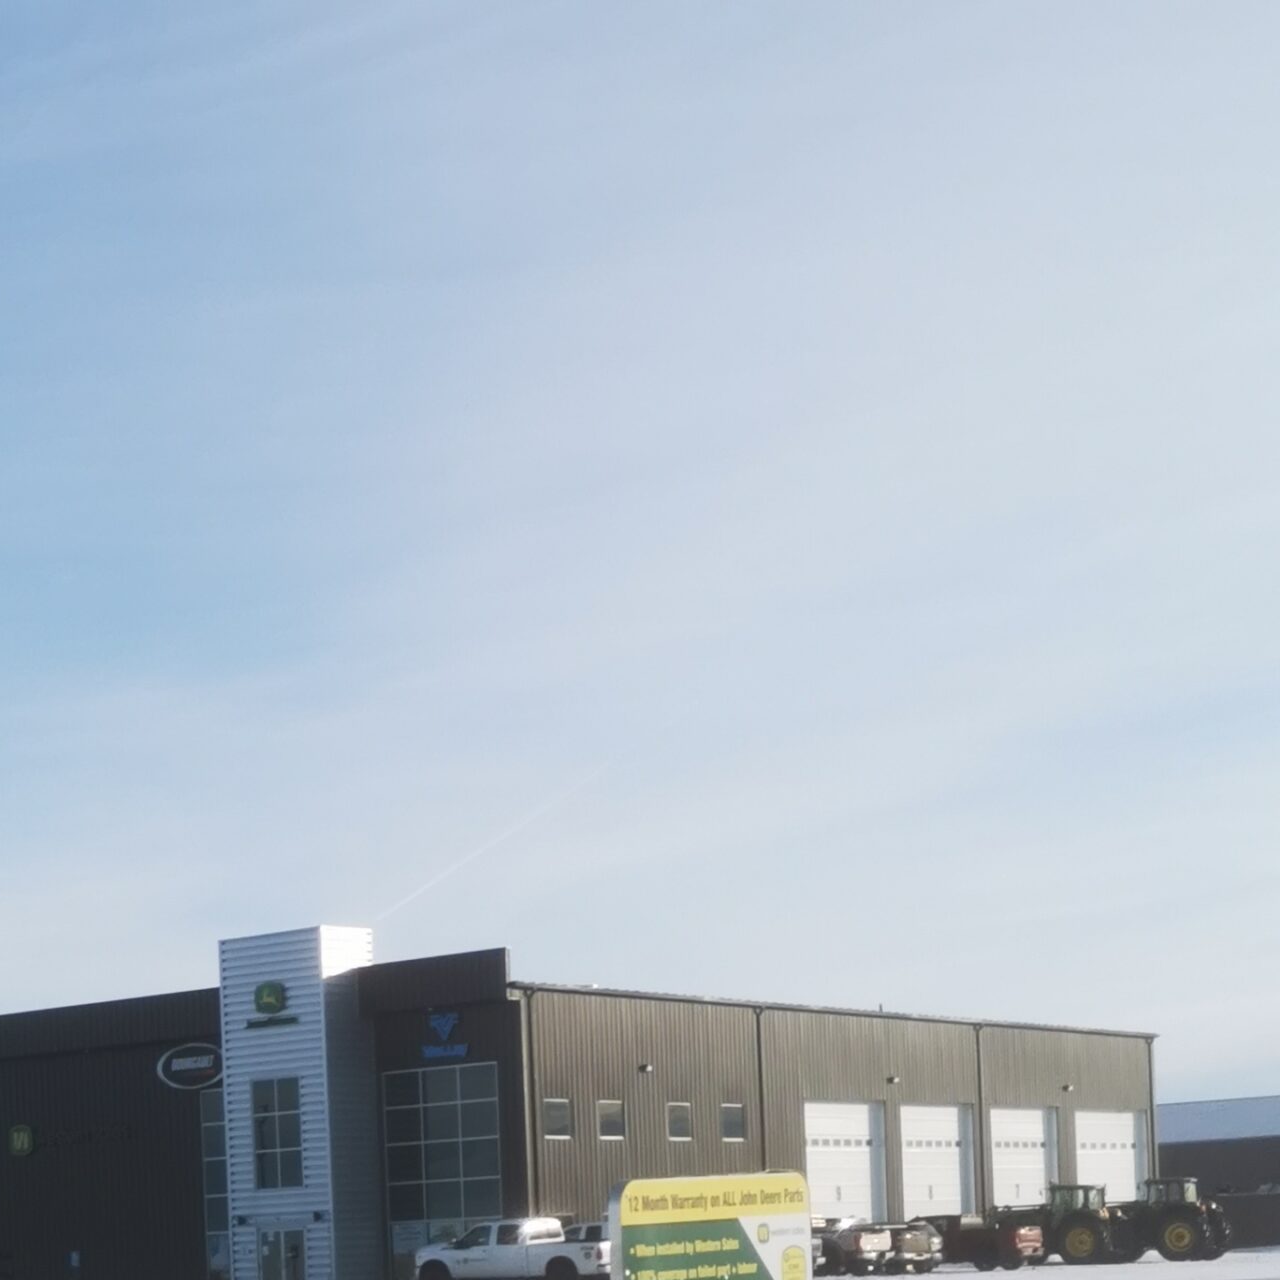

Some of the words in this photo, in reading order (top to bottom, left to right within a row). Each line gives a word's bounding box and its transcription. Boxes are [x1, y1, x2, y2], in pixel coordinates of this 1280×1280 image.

[628, 1195, 640, 1213] 12
[641, 1194, 669, 1212] Month
[670, 1192, 708, 1213] Warranty
[710, 1195, 720, 1208] on
[722, 1191, 737, 1207] ALL
[739, 1190, 758, 1206] John
[760, 1189, 782, 1205] Deere
[783, 1187, 804, 1203] Parts
